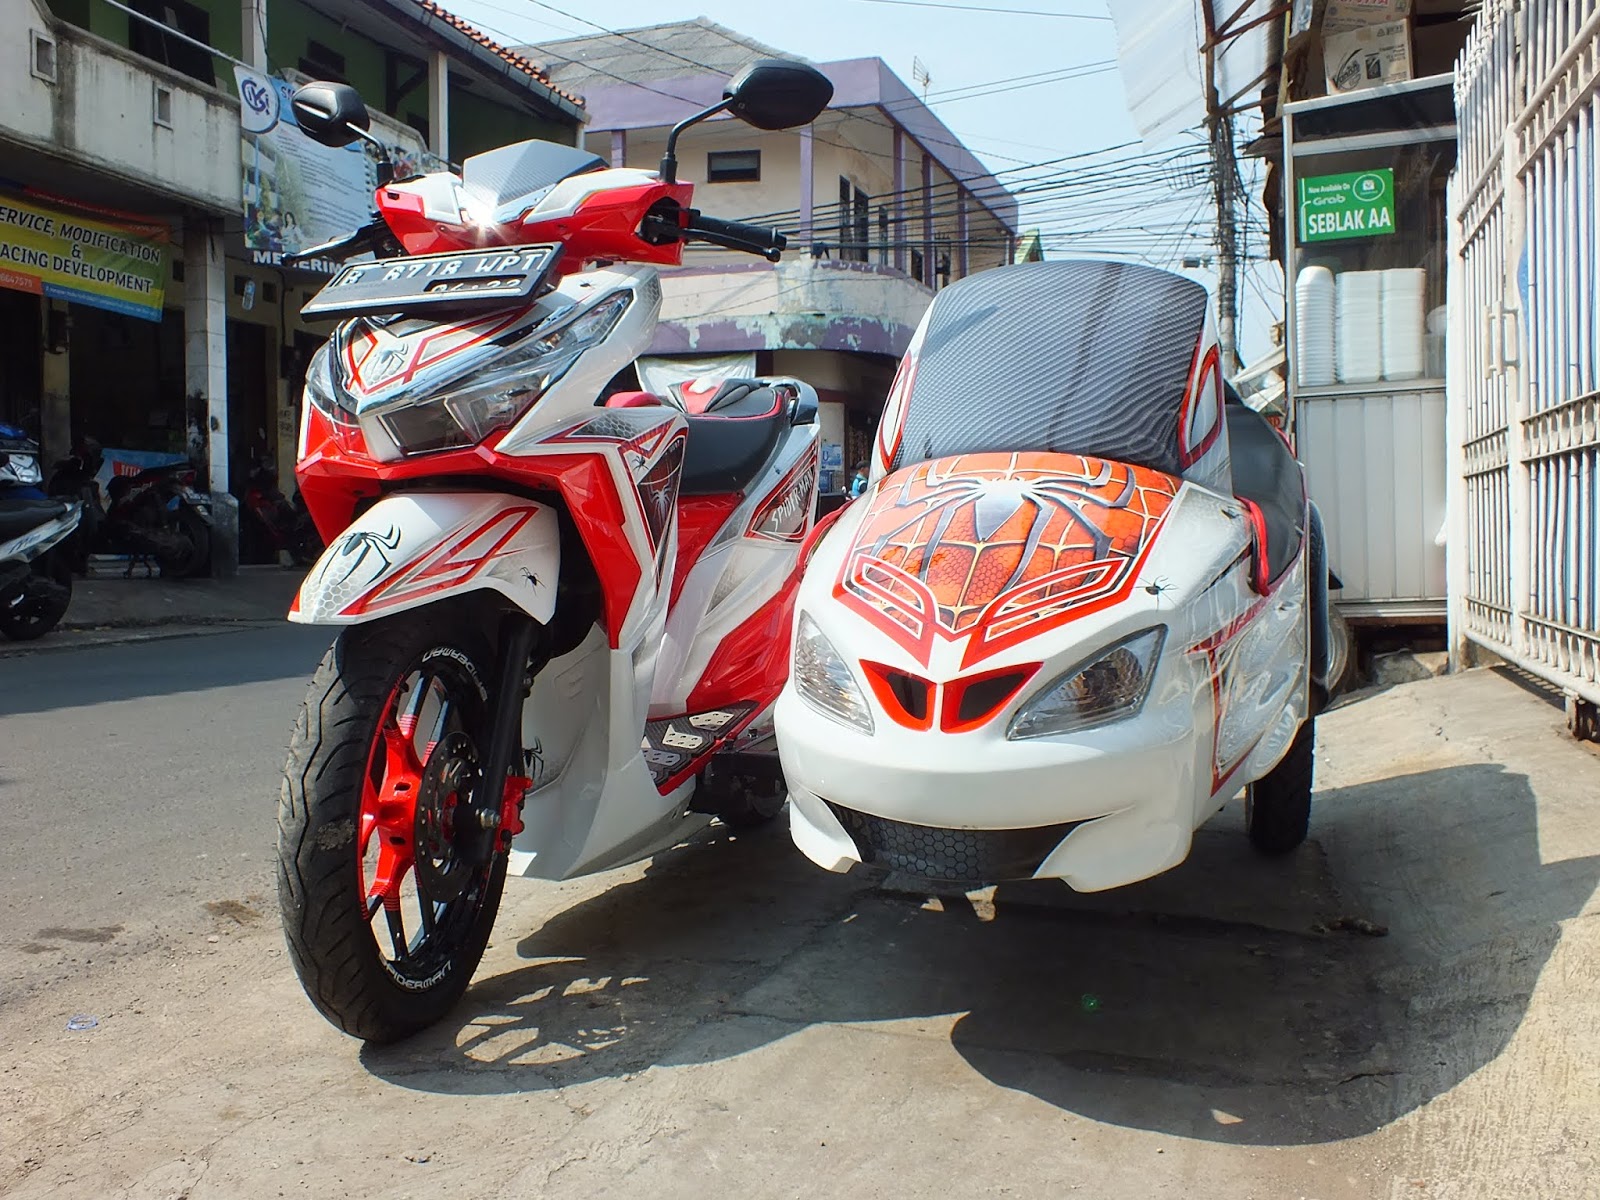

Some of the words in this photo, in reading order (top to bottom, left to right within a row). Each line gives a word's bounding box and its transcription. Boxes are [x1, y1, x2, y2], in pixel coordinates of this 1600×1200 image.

[1312, 194, 1346, 206] Grab
[1308, 209, 1365, 235] SEBLAK
[1368, 206, 1392, 229] AA
[59, 223, 161, 263] MODIFICATION
[71, 244, 82, 260] &
[0, 244, 48, 268] ACING
[53, 256, 152, 293] DEVELOPMENT
[341, 269, 365, 286] B
[474, 253, 543, 273] WPT
[771, 468, 814, 532] SPIDER-MAN
